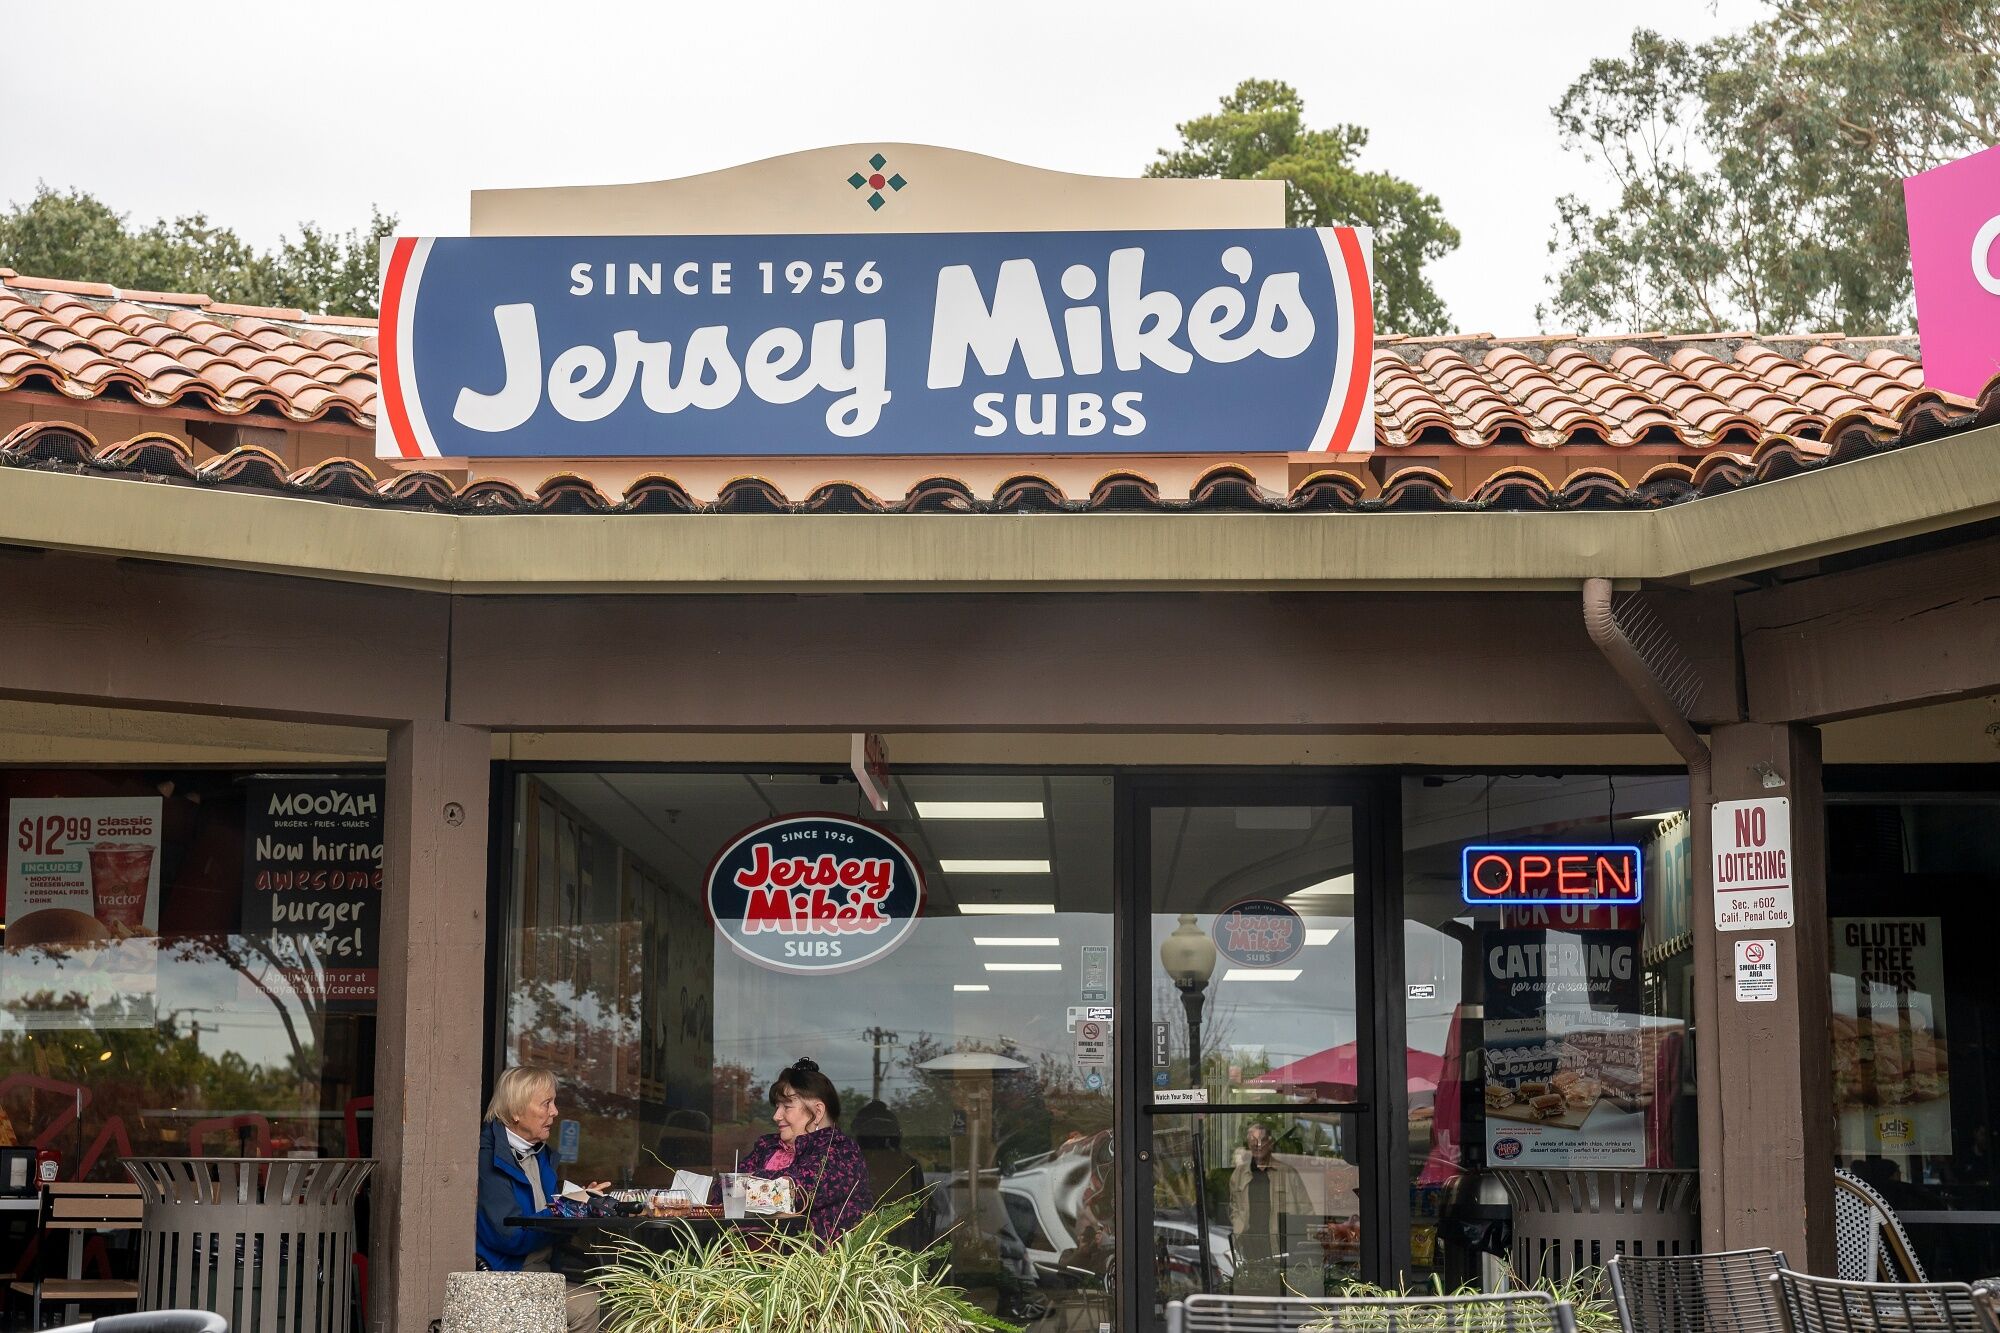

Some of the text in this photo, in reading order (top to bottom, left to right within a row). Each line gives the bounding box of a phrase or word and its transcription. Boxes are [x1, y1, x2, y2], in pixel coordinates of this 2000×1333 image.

[570, 260, 884, 296] SINCE 1956
[452, 246, 1316, 438] Jersey Mike's
[972, 391, 1148, 437] SUBS
[267, 790, 377, 816] MOOYAH
[97, 816, 153, 826] classic
[97, 826, 152, 836] combo
[274, 820, 370, 828] BURGERS FRIES SHAKES
[1734, 806, 1767, 848] NO
[781, 830, 855, 844] SINCE 1956
[256, 834, 384, 869] Now hiring
[24, 863, 80, 873] INCLUDES
[735, 844, 893, 901] Jersey
[1473, 854, 1631, 895] OPEN
[1717, 849, 1787, 883] LOITERING
[255, 870, 383, 891] awesome
[98, 894, 141, 905] tractor
[271, 893, 365, 931] burger
[743, 888, 889, 935] Mike's
[1732, 897, 1776, 910] Sec. #602
[1225, 910, 1293, 937] Jersey
[1721, 909, 1788, 923] Calif. Penal Code
[1845, 922, 1926, 947] GLUTEN
[784, 940, 842, 958] SUBS
[1246, 953, 1271, 962] SUBS
[1489, 943, 1632, 980] CATERING
[1861, 946, 1914, 971] FREE
[354, 973, 366, 982] at
[1739, 963, 1772, 971] SMOKE-FREE
[1511, 981, 1531, 996] for
[1860, 971, 1917, 996] SUBS
[1156, 1025, 1166, 1065] PULL
[1499, 1057, 1553, 1076] Jersey
[1182, 1093, 1193, 1101] Step
